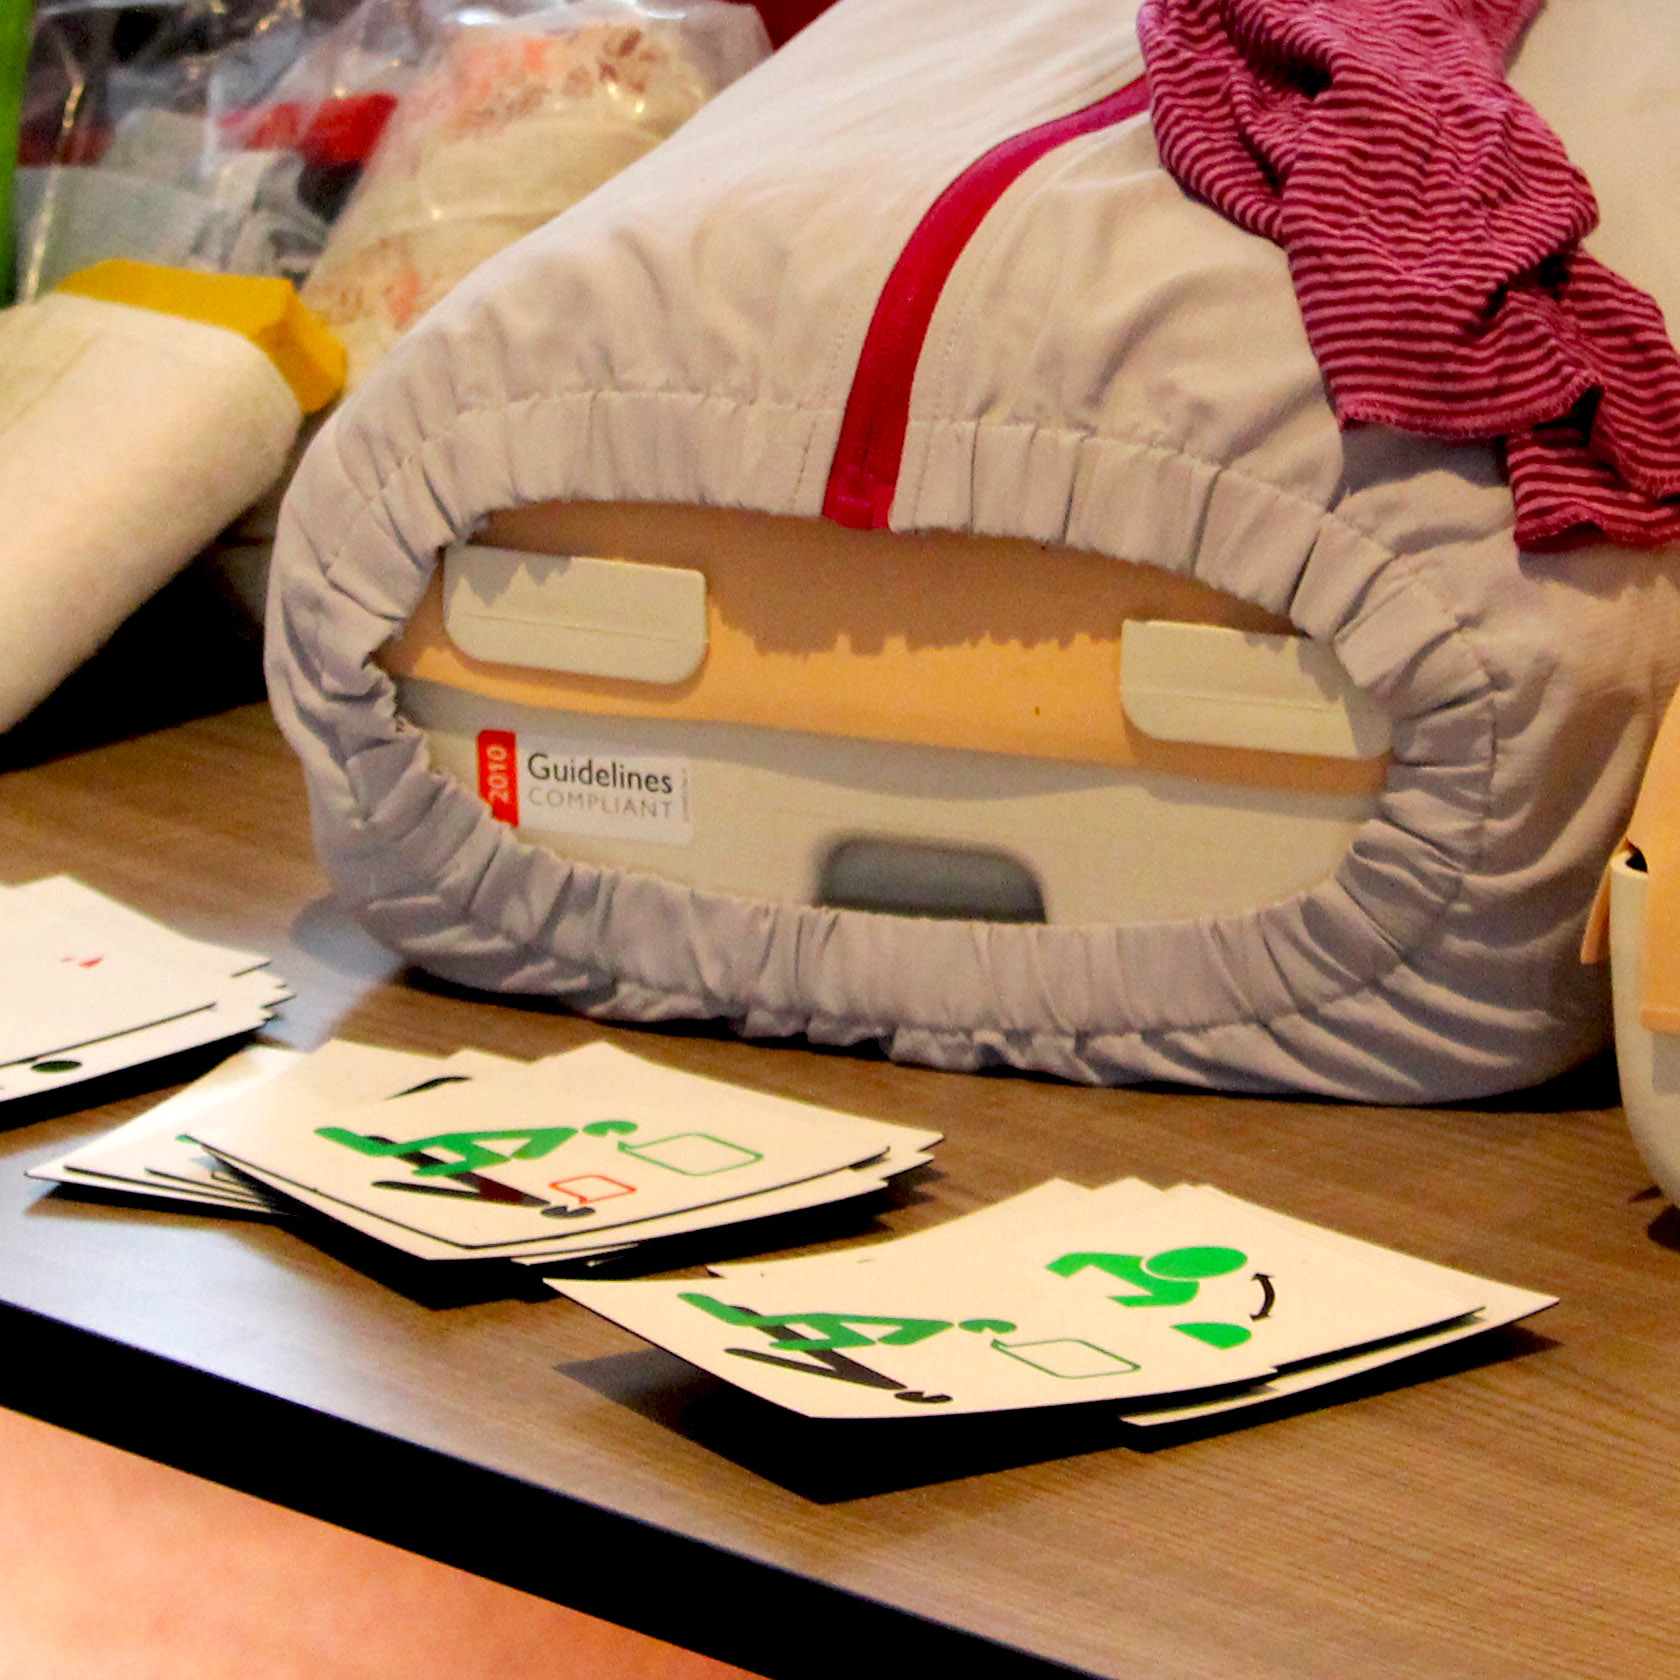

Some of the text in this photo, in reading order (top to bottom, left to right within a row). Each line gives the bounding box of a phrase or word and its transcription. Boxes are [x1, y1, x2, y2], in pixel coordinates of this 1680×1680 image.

[486, 743, 510, 804] 2010
[527, 752, 673, 794] Guidelines
[527, 786, 673, 820] COMPLIANT
